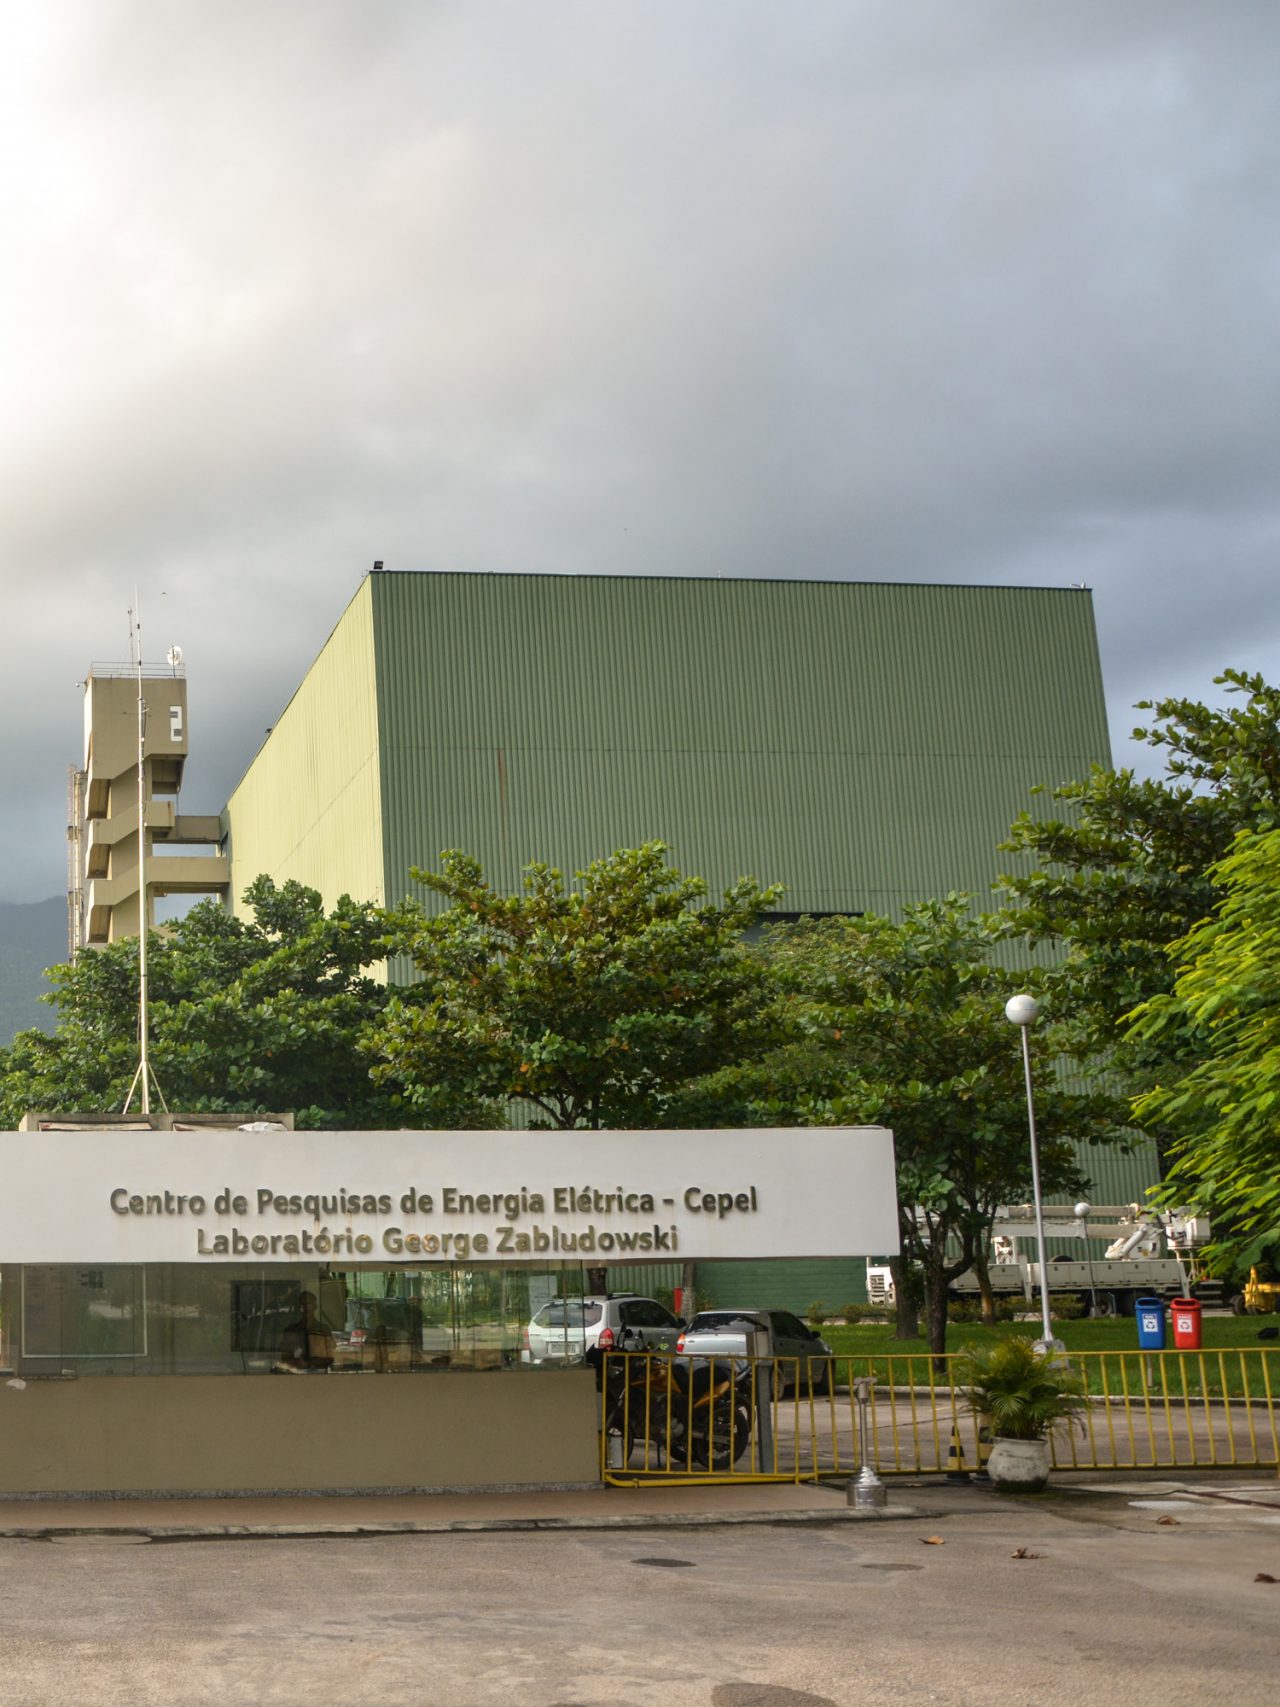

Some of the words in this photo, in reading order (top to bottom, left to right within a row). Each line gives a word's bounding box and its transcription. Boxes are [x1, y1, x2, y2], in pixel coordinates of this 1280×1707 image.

[170, 705, 183, 742] 2
[110, 1188, 206, 1215] Centro
[214, 1187, 248, 1215] de
[256, 1187, 392, 1222] Pesquisas
[400, 1186, 434, 1214] de
[442, 1186, 545, 1221] Energia
[553, 1185, 655, 1213] Elétrica
[684, 1186, 757, 1219] Cepel
[197, 1226, 373, 1256] Laboratório
[382, 1227, 489, 1260] George
[496, 1225, 679, 1252] Zabludowski
